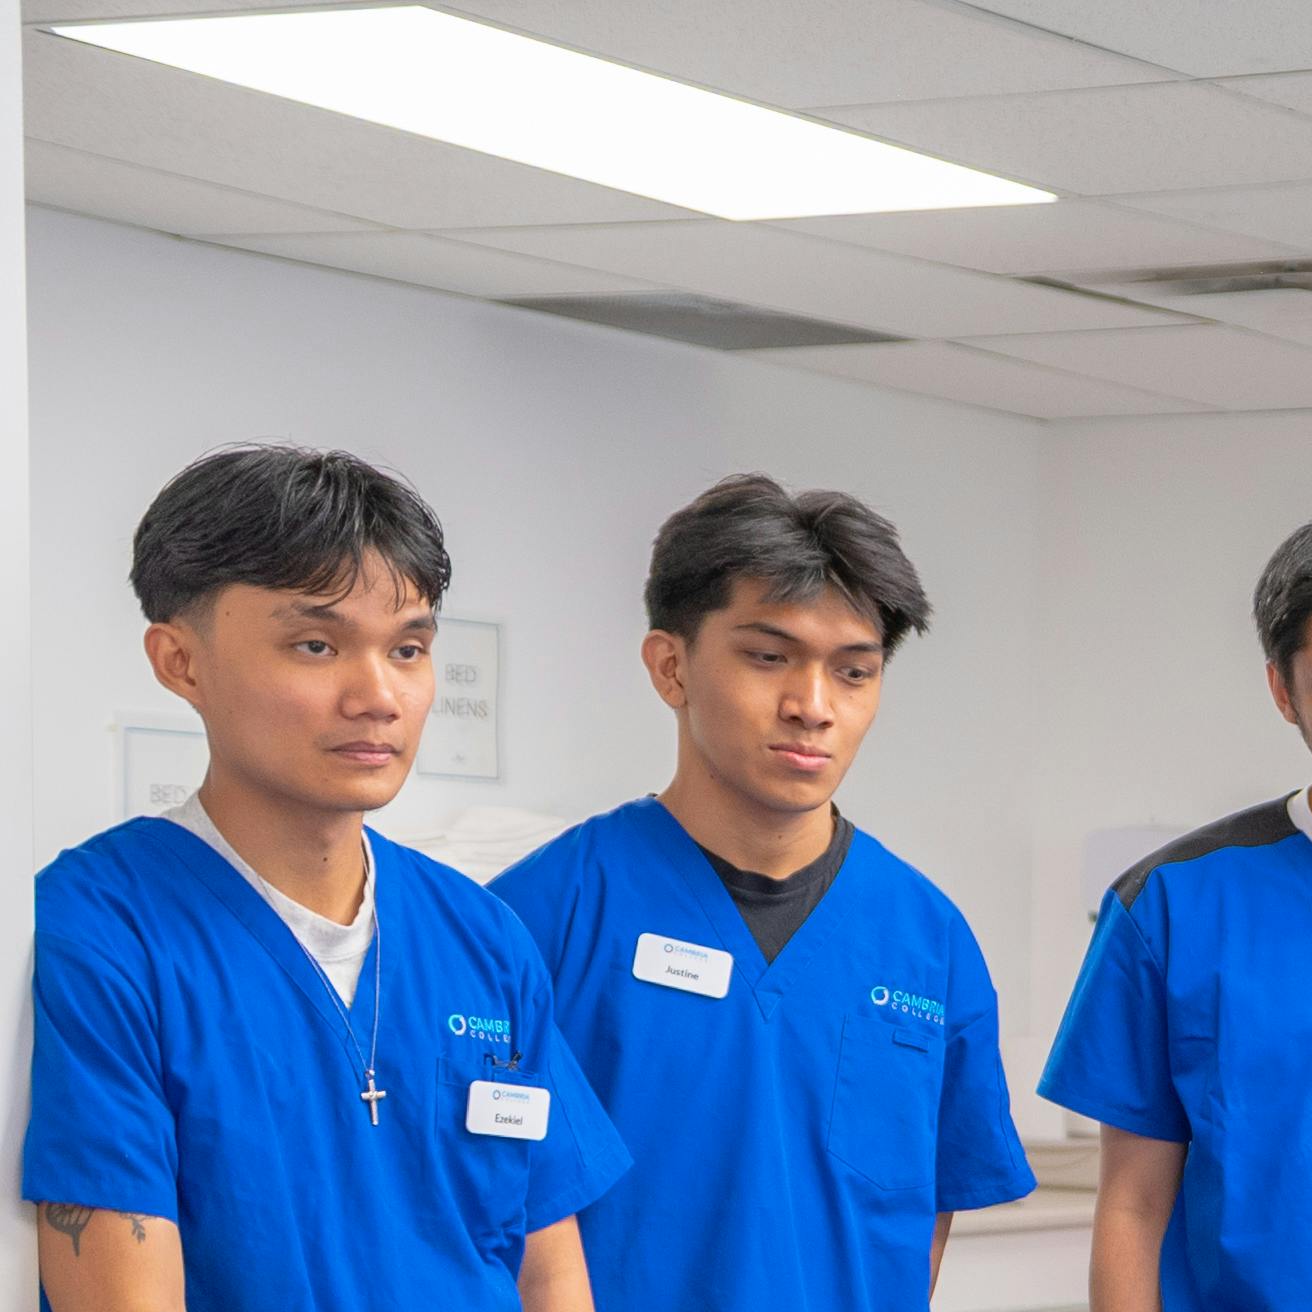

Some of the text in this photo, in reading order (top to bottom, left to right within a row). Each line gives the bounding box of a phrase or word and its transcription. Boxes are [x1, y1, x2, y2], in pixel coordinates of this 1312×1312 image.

[665, 965, 699, 980] Justine
[468, 1016, 510, 1033] CAMBR
[494, 1112, 523, 1126] Ezekiel
